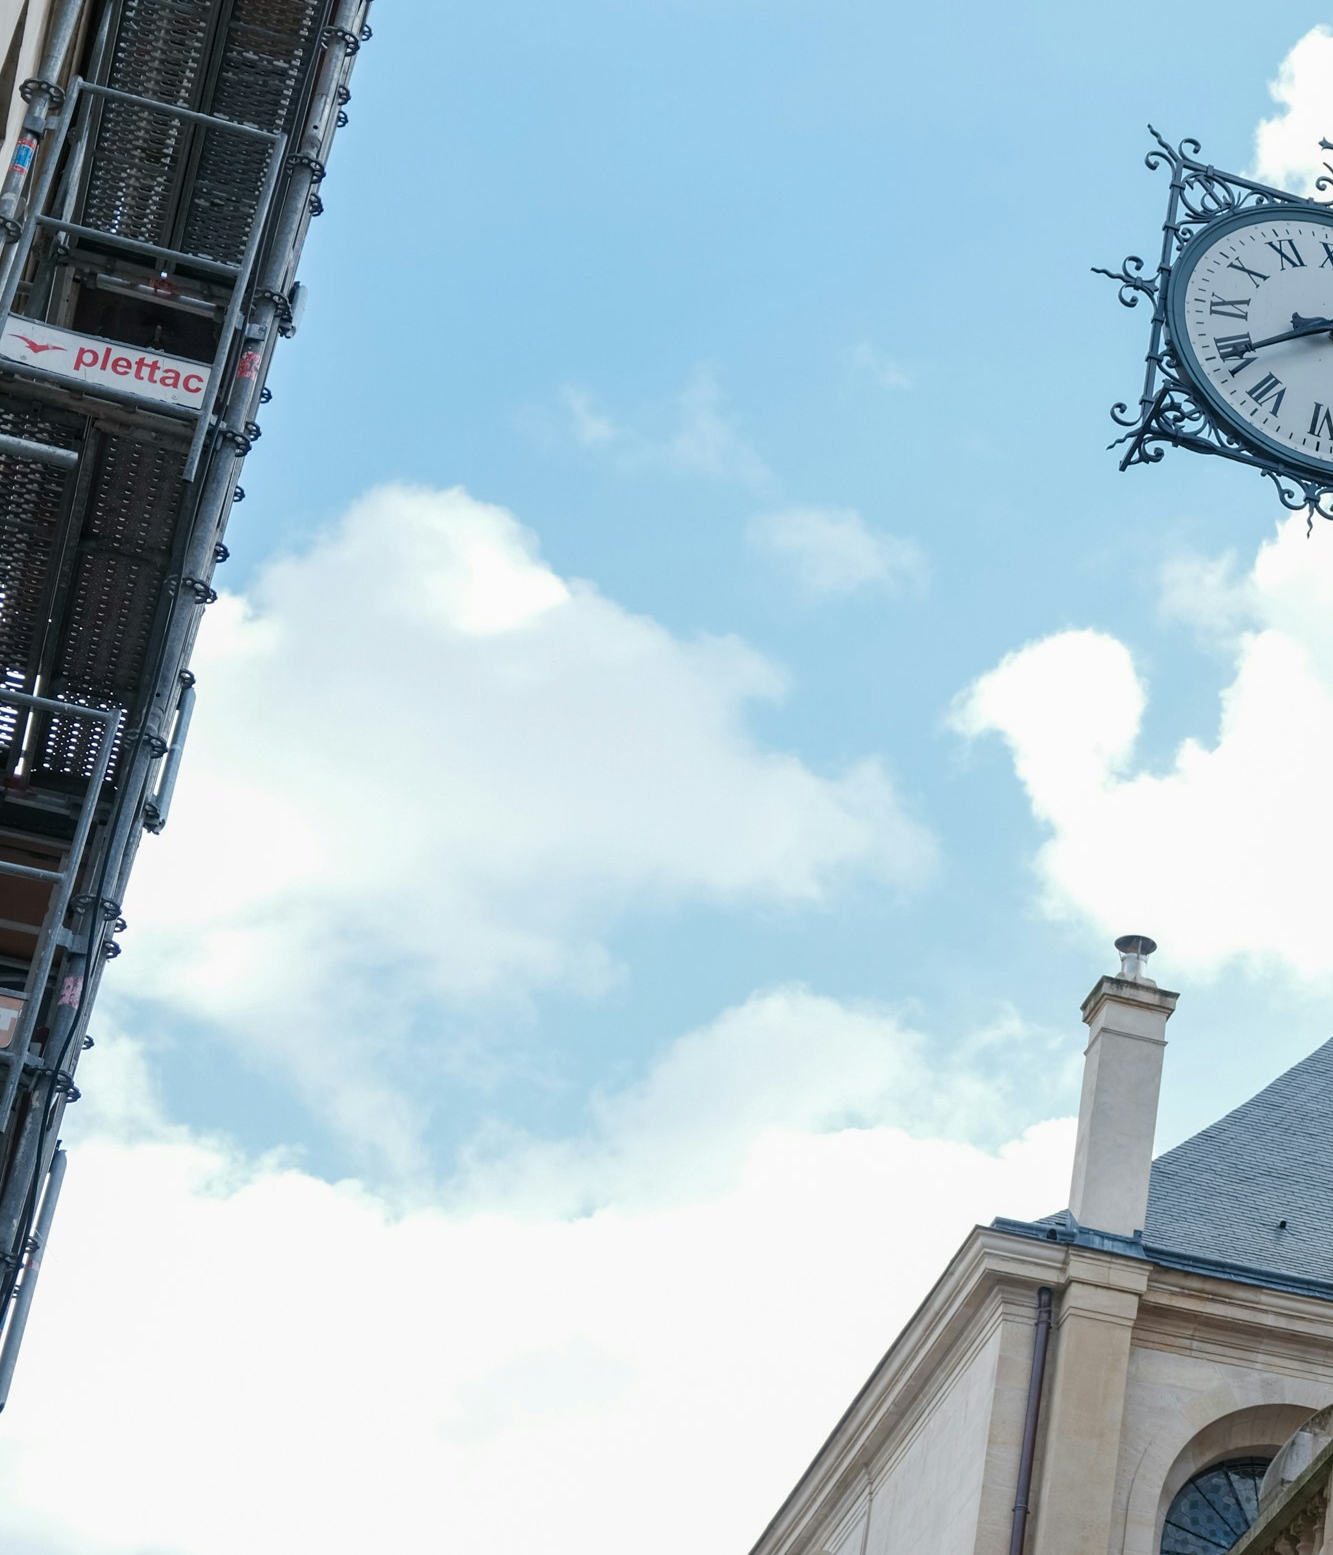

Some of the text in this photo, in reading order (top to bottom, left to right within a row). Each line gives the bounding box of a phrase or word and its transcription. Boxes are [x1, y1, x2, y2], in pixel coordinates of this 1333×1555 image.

[1264, 239, 1308, 272] XI
[1227, 256, 1270, 288] X
[1209, 292, 1251, 321] IX
[73, 346, 205, 394] plettac
